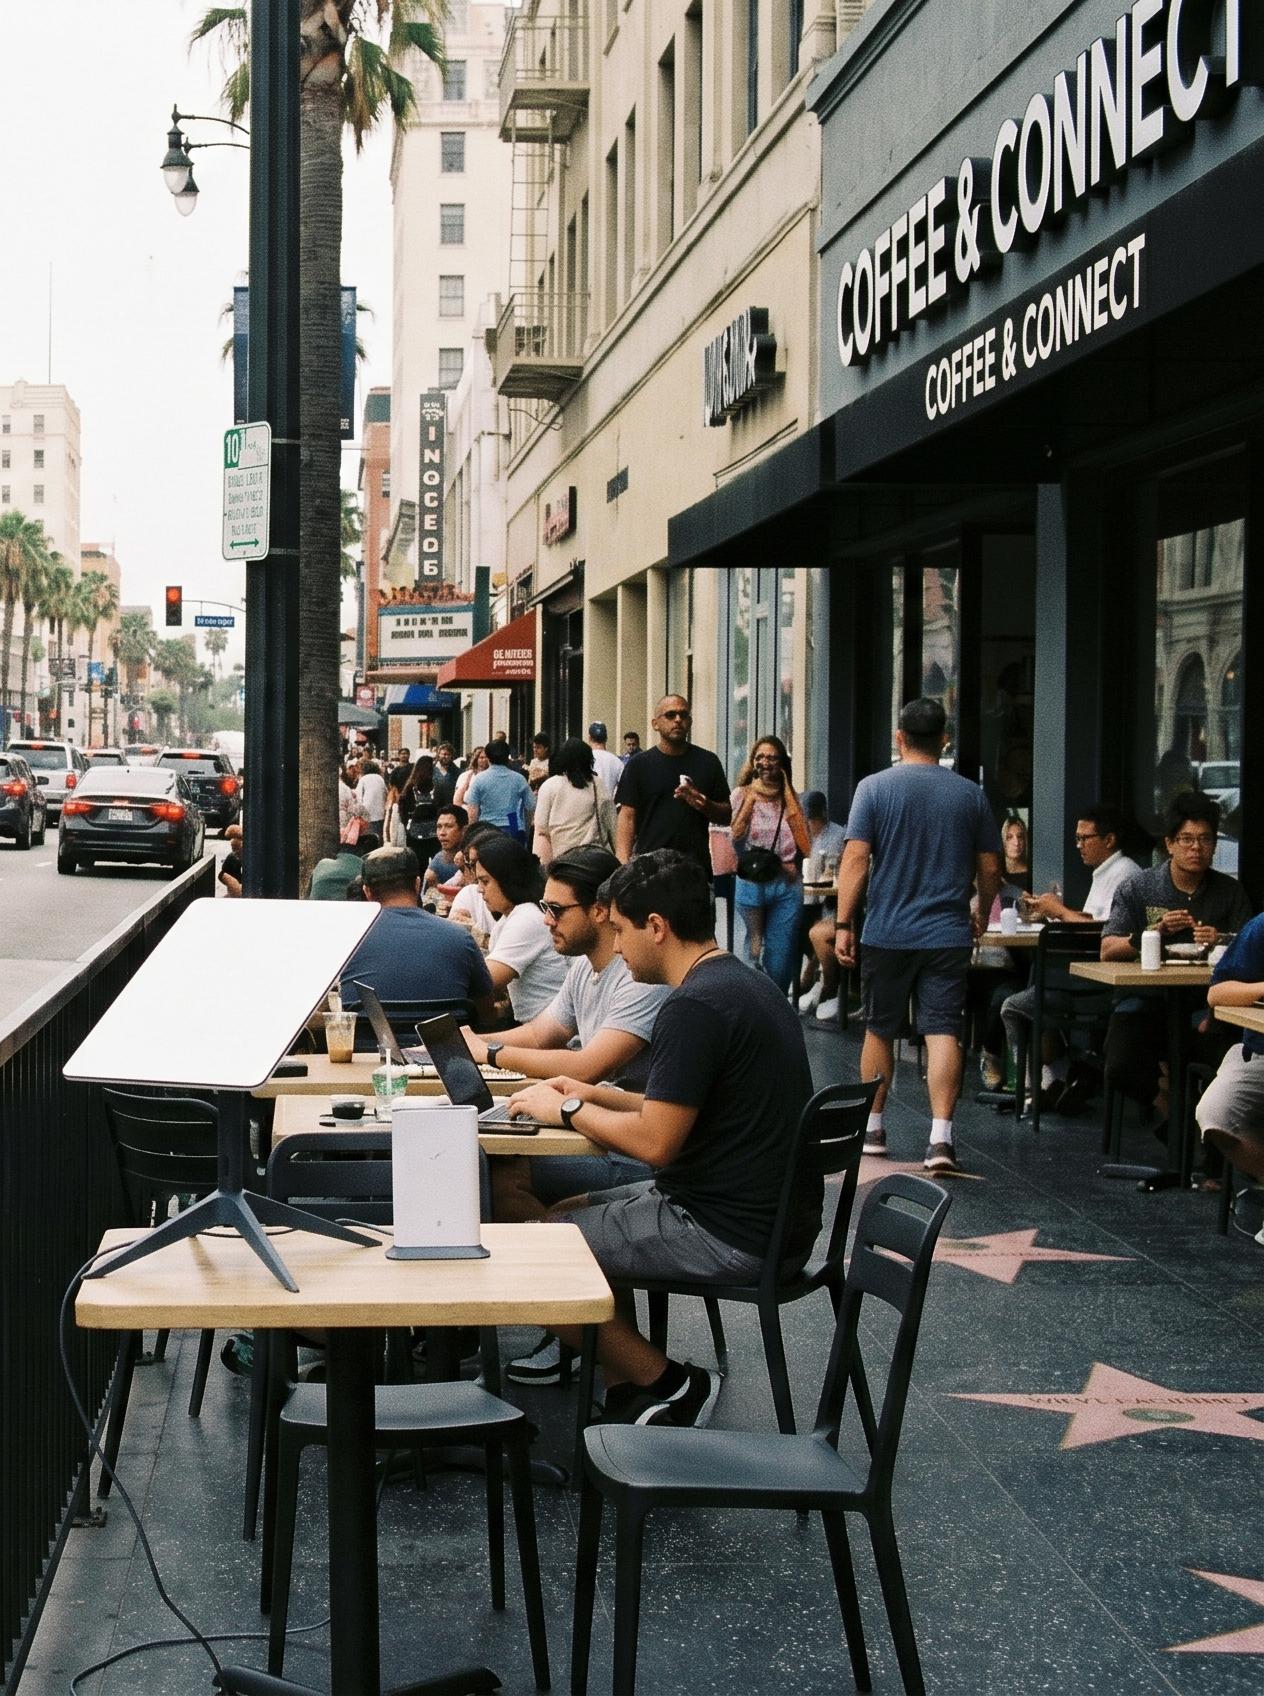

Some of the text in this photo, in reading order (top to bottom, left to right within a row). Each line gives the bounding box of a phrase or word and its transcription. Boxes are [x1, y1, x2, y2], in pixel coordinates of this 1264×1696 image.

[837, 176, 947, 368] COFFEE
[954, 157, 981, 284] &
[925, 232, 1146, 421] COFFEE & CONNECT
[225, 432, 240, 465] 10
